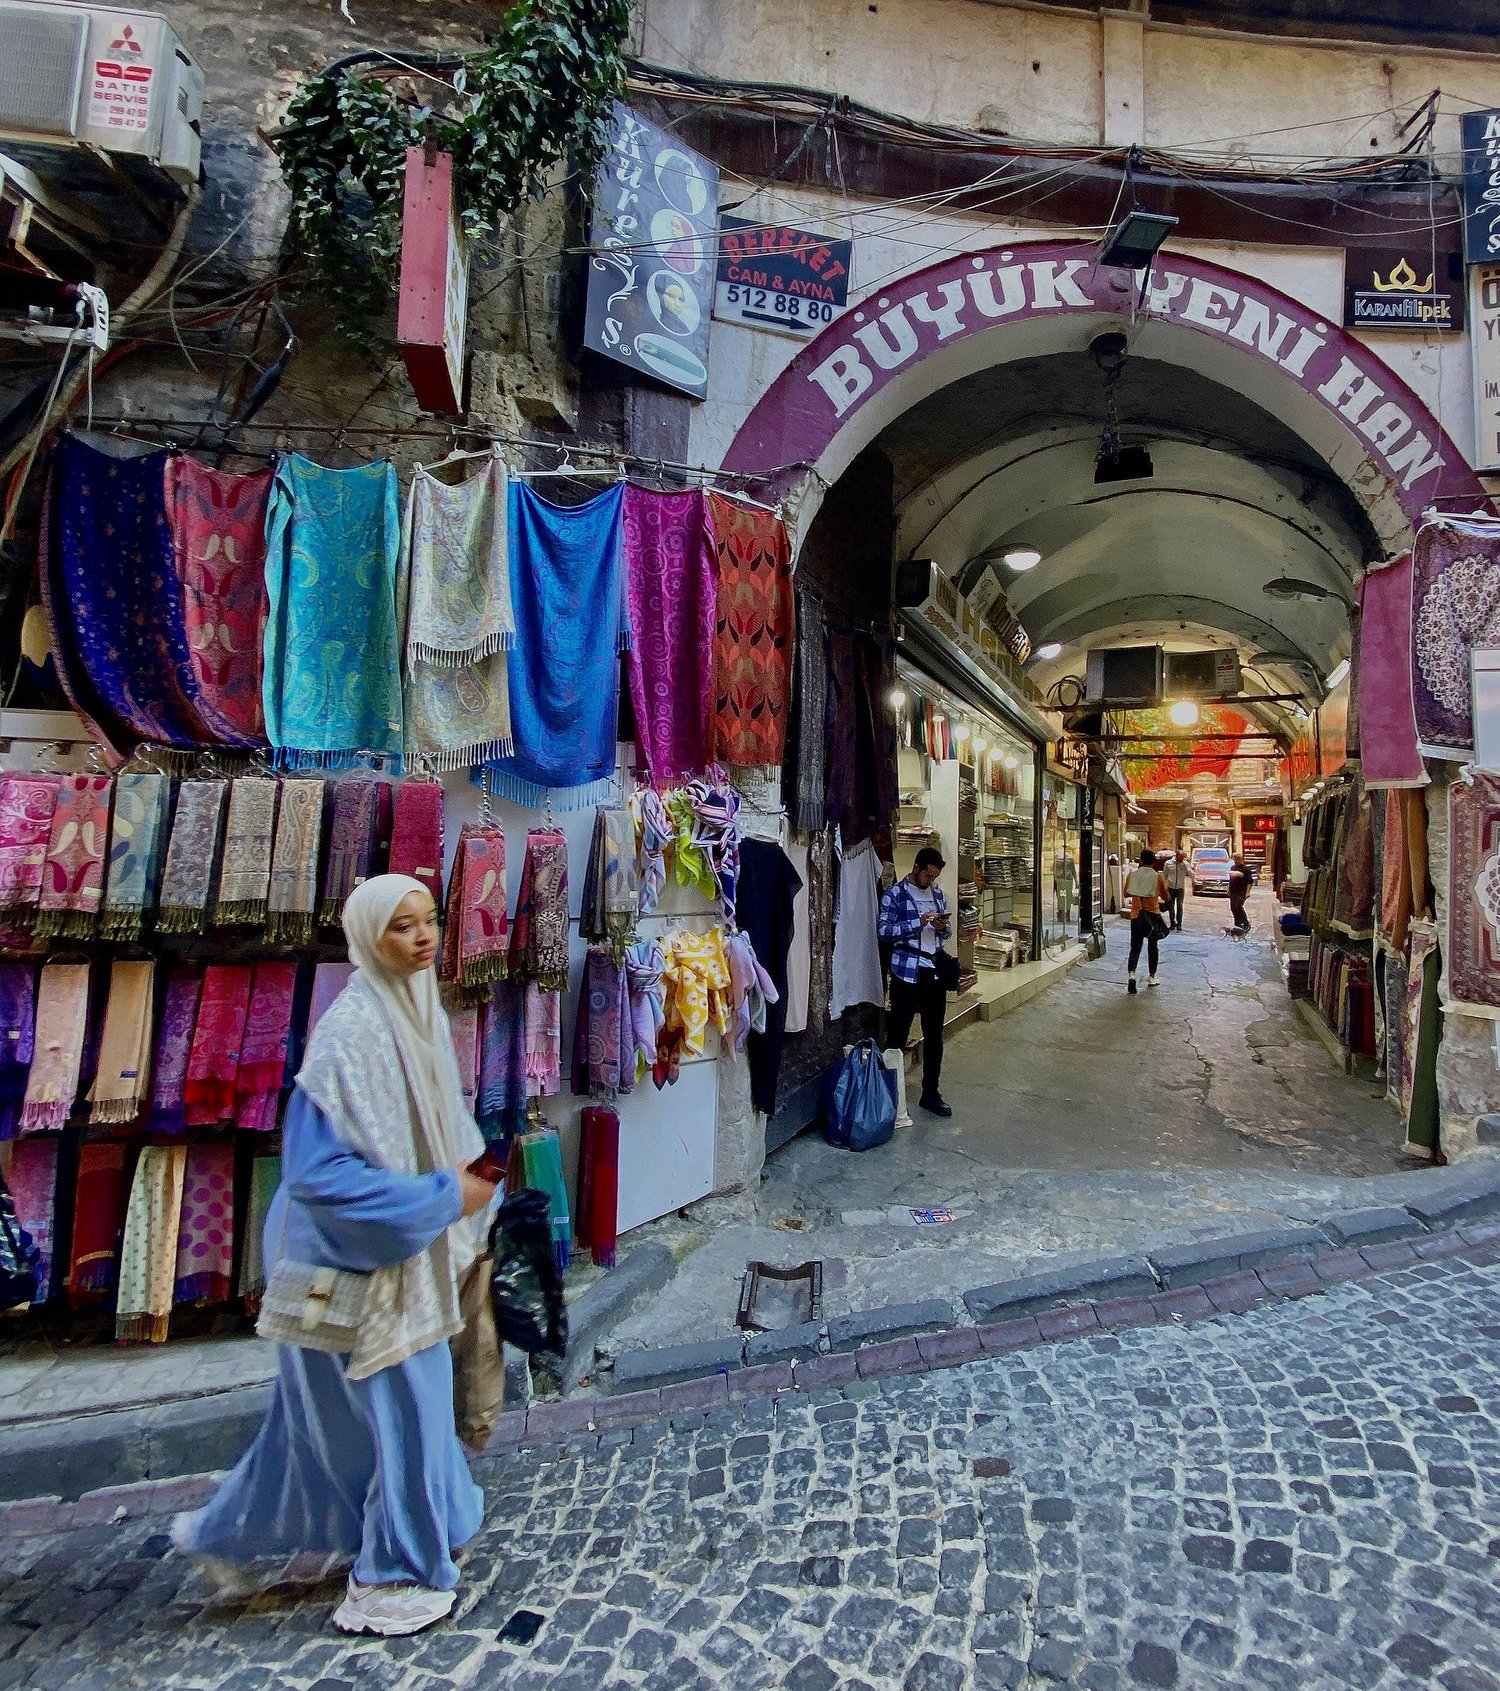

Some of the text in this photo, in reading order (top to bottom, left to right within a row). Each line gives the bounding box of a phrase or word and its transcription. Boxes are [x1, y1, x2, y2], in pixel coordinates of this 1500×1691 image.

[723, 227, 846, 280] BEREKET
[727, 265, 835, 302] CAM & AYNA
[727, 284, 833, 323] 512 88 80
[806, 251, 1446, 491] BÜYÜK YENİ HAN
